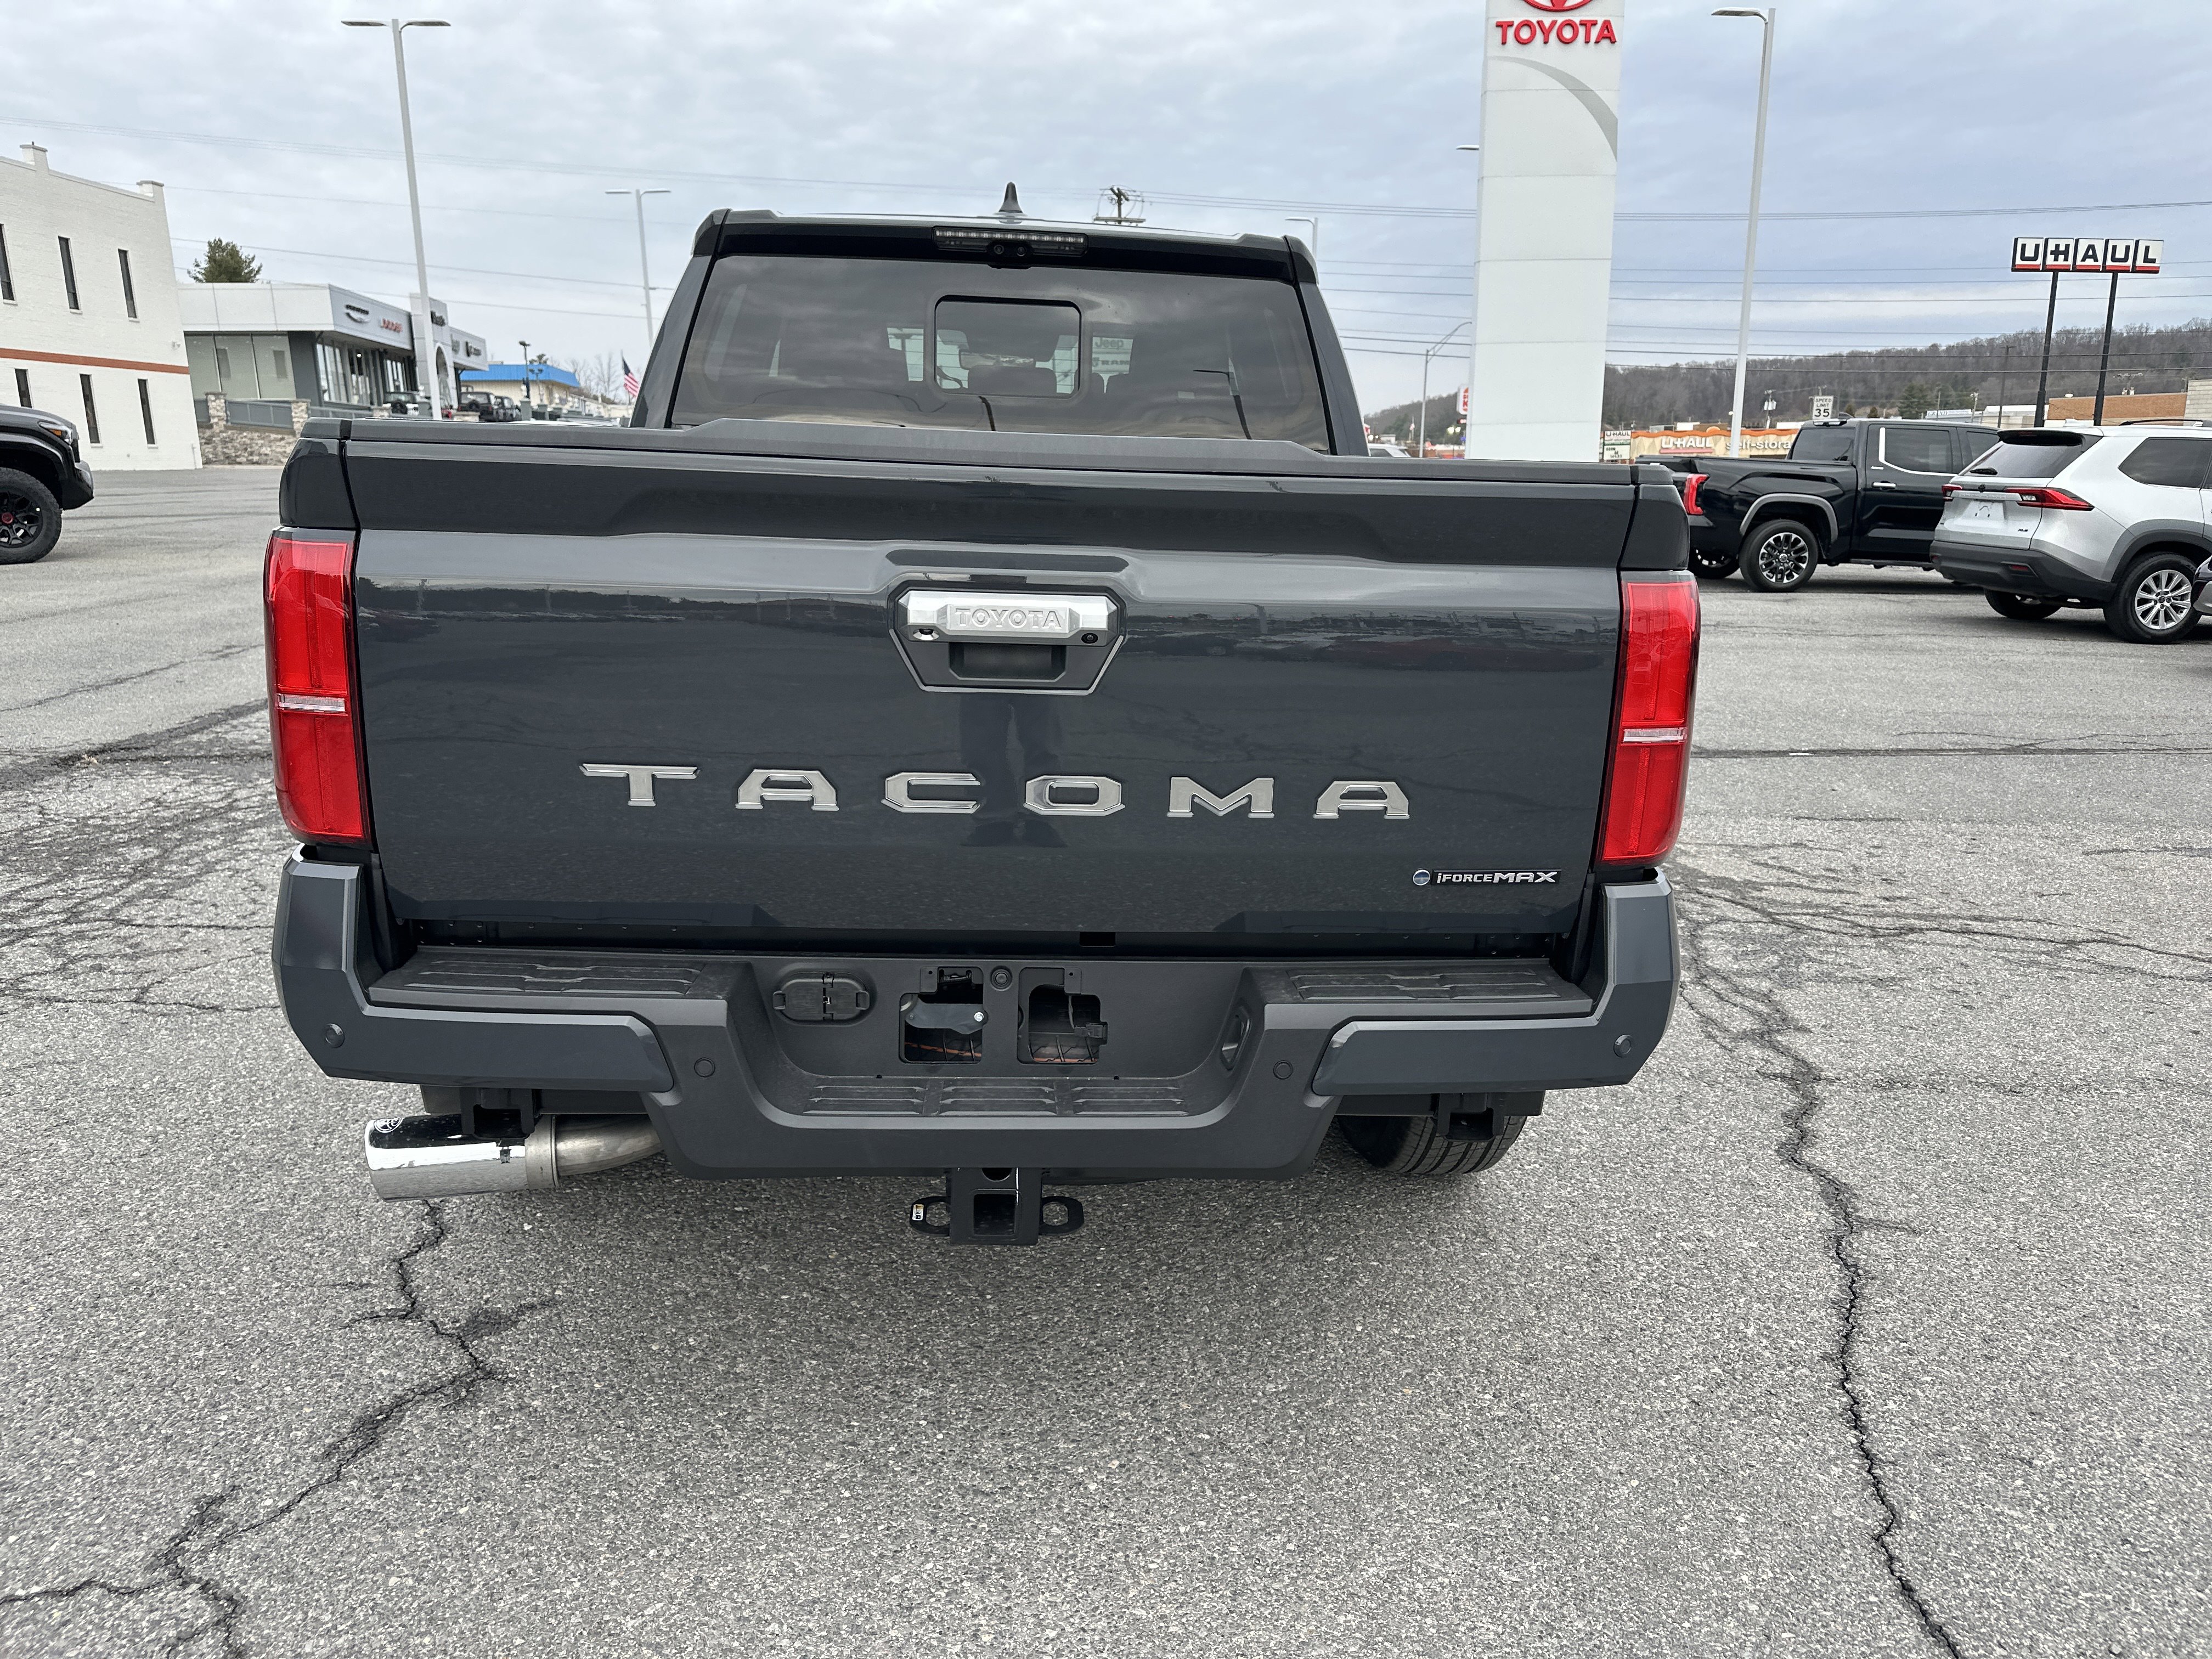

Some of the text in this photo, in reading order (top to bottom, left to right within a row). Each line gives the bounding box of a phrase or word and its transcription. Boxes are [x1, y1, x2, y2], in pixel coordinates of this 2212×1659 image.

[1496, 19, 1617, 44] TOYOTA
[1095, 337, 1124, 350] Jeep
[1814, 408, 1830, 417] 35
[1726, 439, 1791, 450] slf-stora
[955, 608, 1062, 629] TOYOTA
[579, 763, 1410, 819] TACOMA
